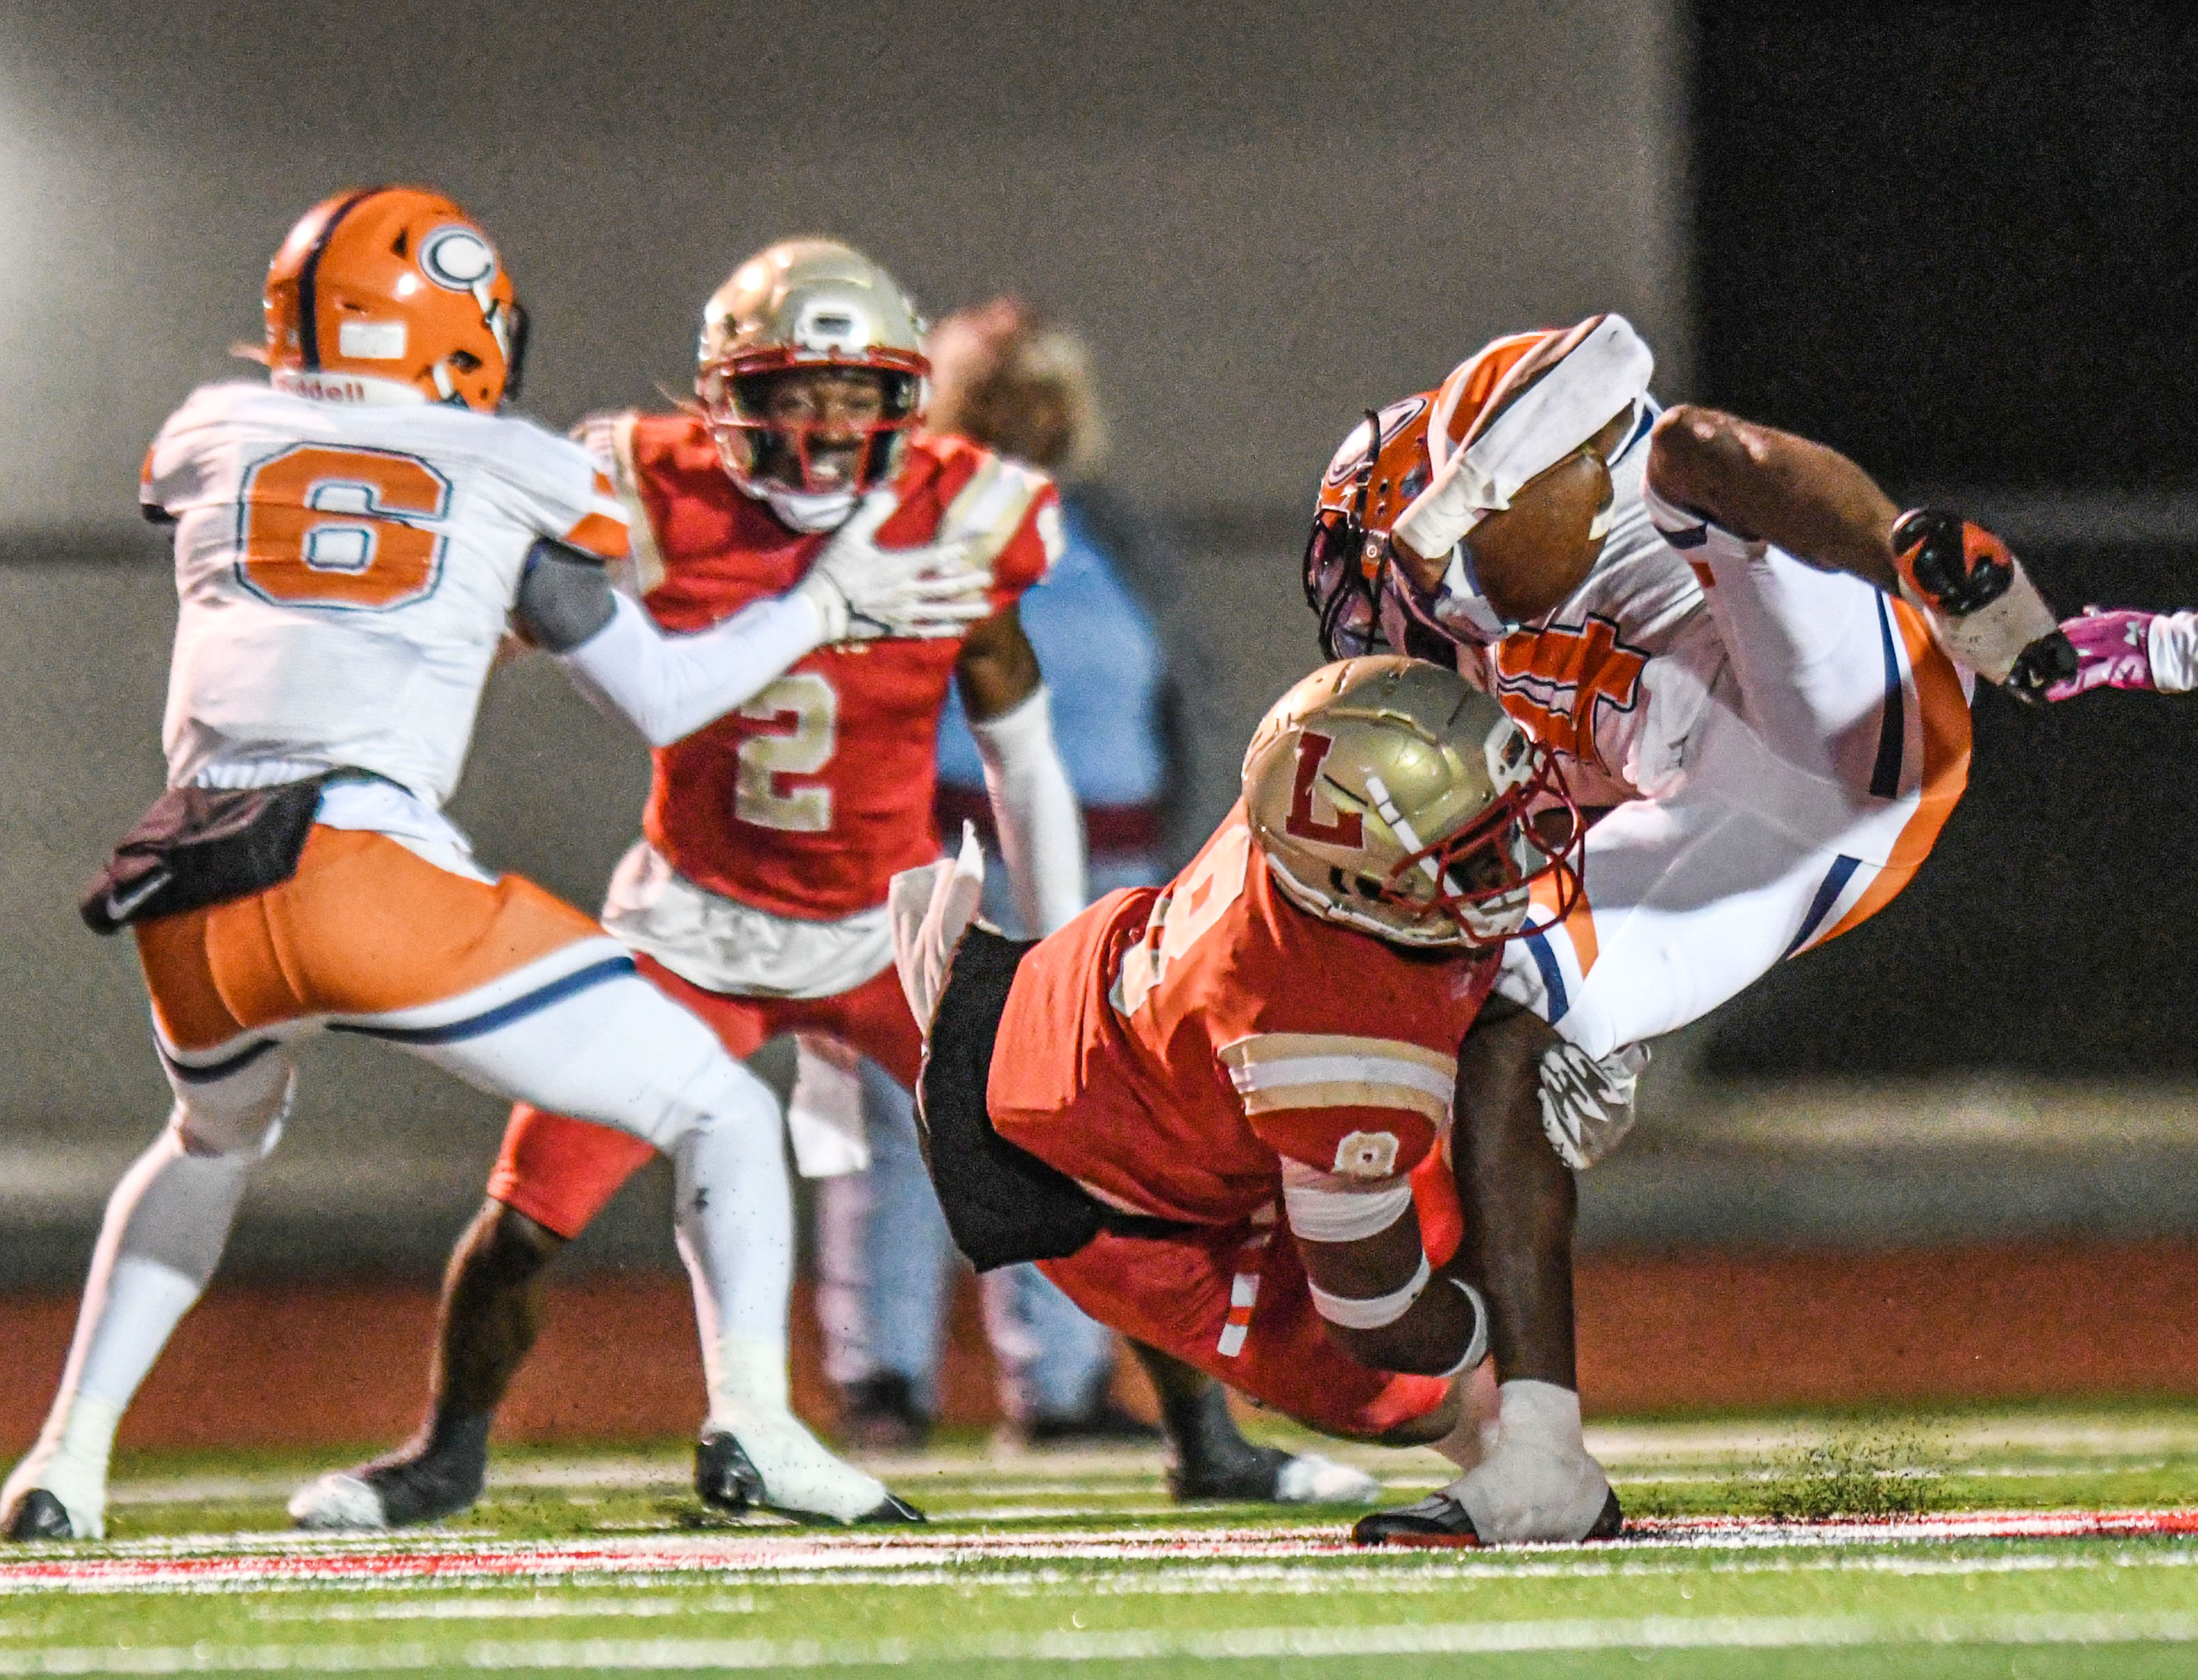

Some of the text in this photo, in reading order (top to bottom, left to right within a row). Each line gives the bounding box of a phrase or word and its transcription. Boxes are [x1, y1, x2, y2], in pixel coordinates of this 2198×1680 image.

[234, 441, 453, 613] 6
[735, 670, 837, 832] 2
[1286, 731, 1363, 849] L
